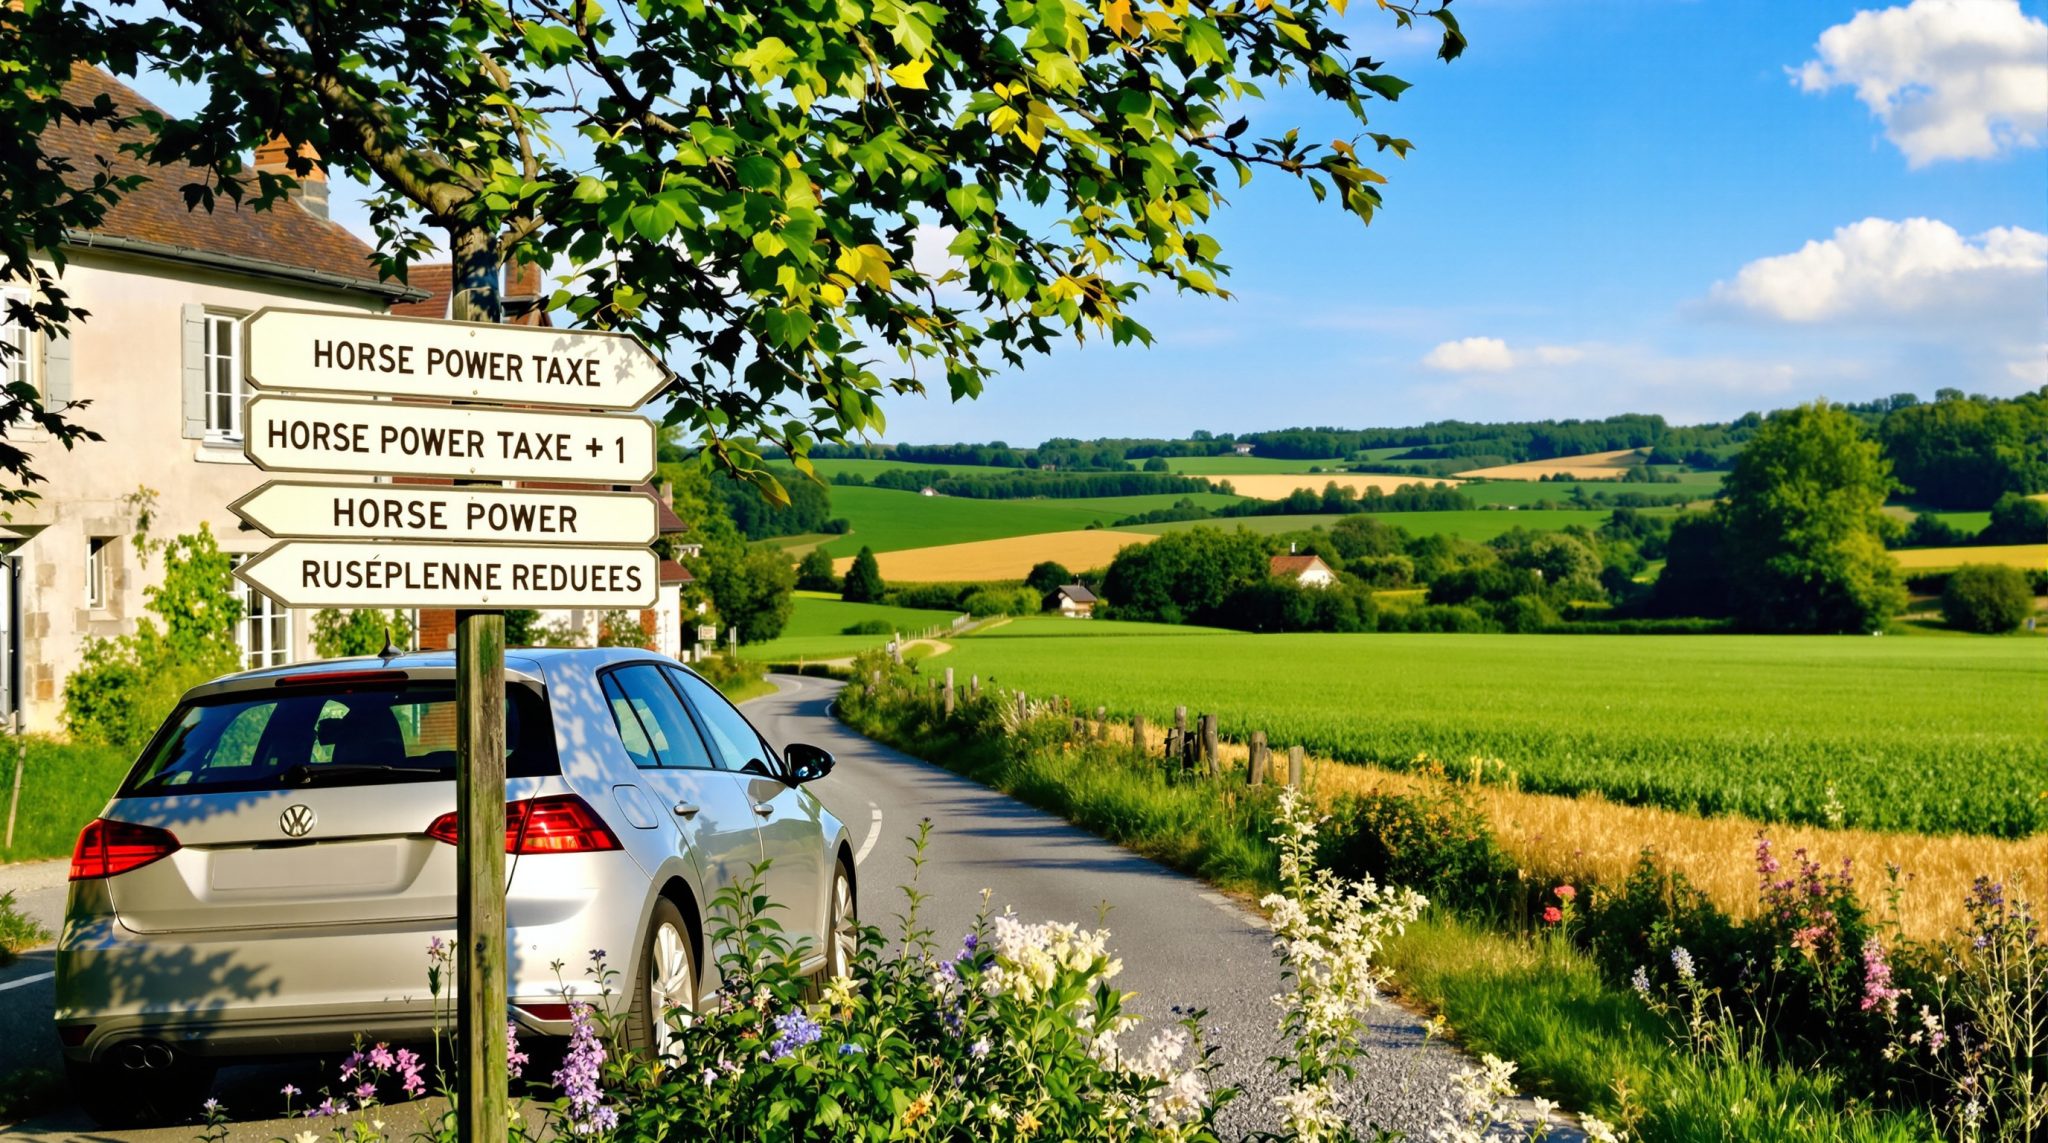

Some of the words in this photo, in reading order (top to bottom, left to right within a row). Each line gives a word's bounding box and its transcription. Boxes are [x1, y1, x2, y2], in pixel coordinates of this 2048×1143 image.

[314, 339, 414, 375] HORSE
[427, 347, 523, 383] POWER
[532, 355, 601, 387] TAXE
[268, 419, 370, 453] HORSE
[381, 425, 485, 458] POWER
[497, 430, 572, 462] TAXE
[585, 437, 603, 458] +
[615, 436, 625, 464] 1
[333, 497, 448, 530] HORSE
[467, 502, 577, 533] POWER
[302, 554, 502, 591] RUSÉPLENNE
[512, 564, 642, 592] REDUEES
